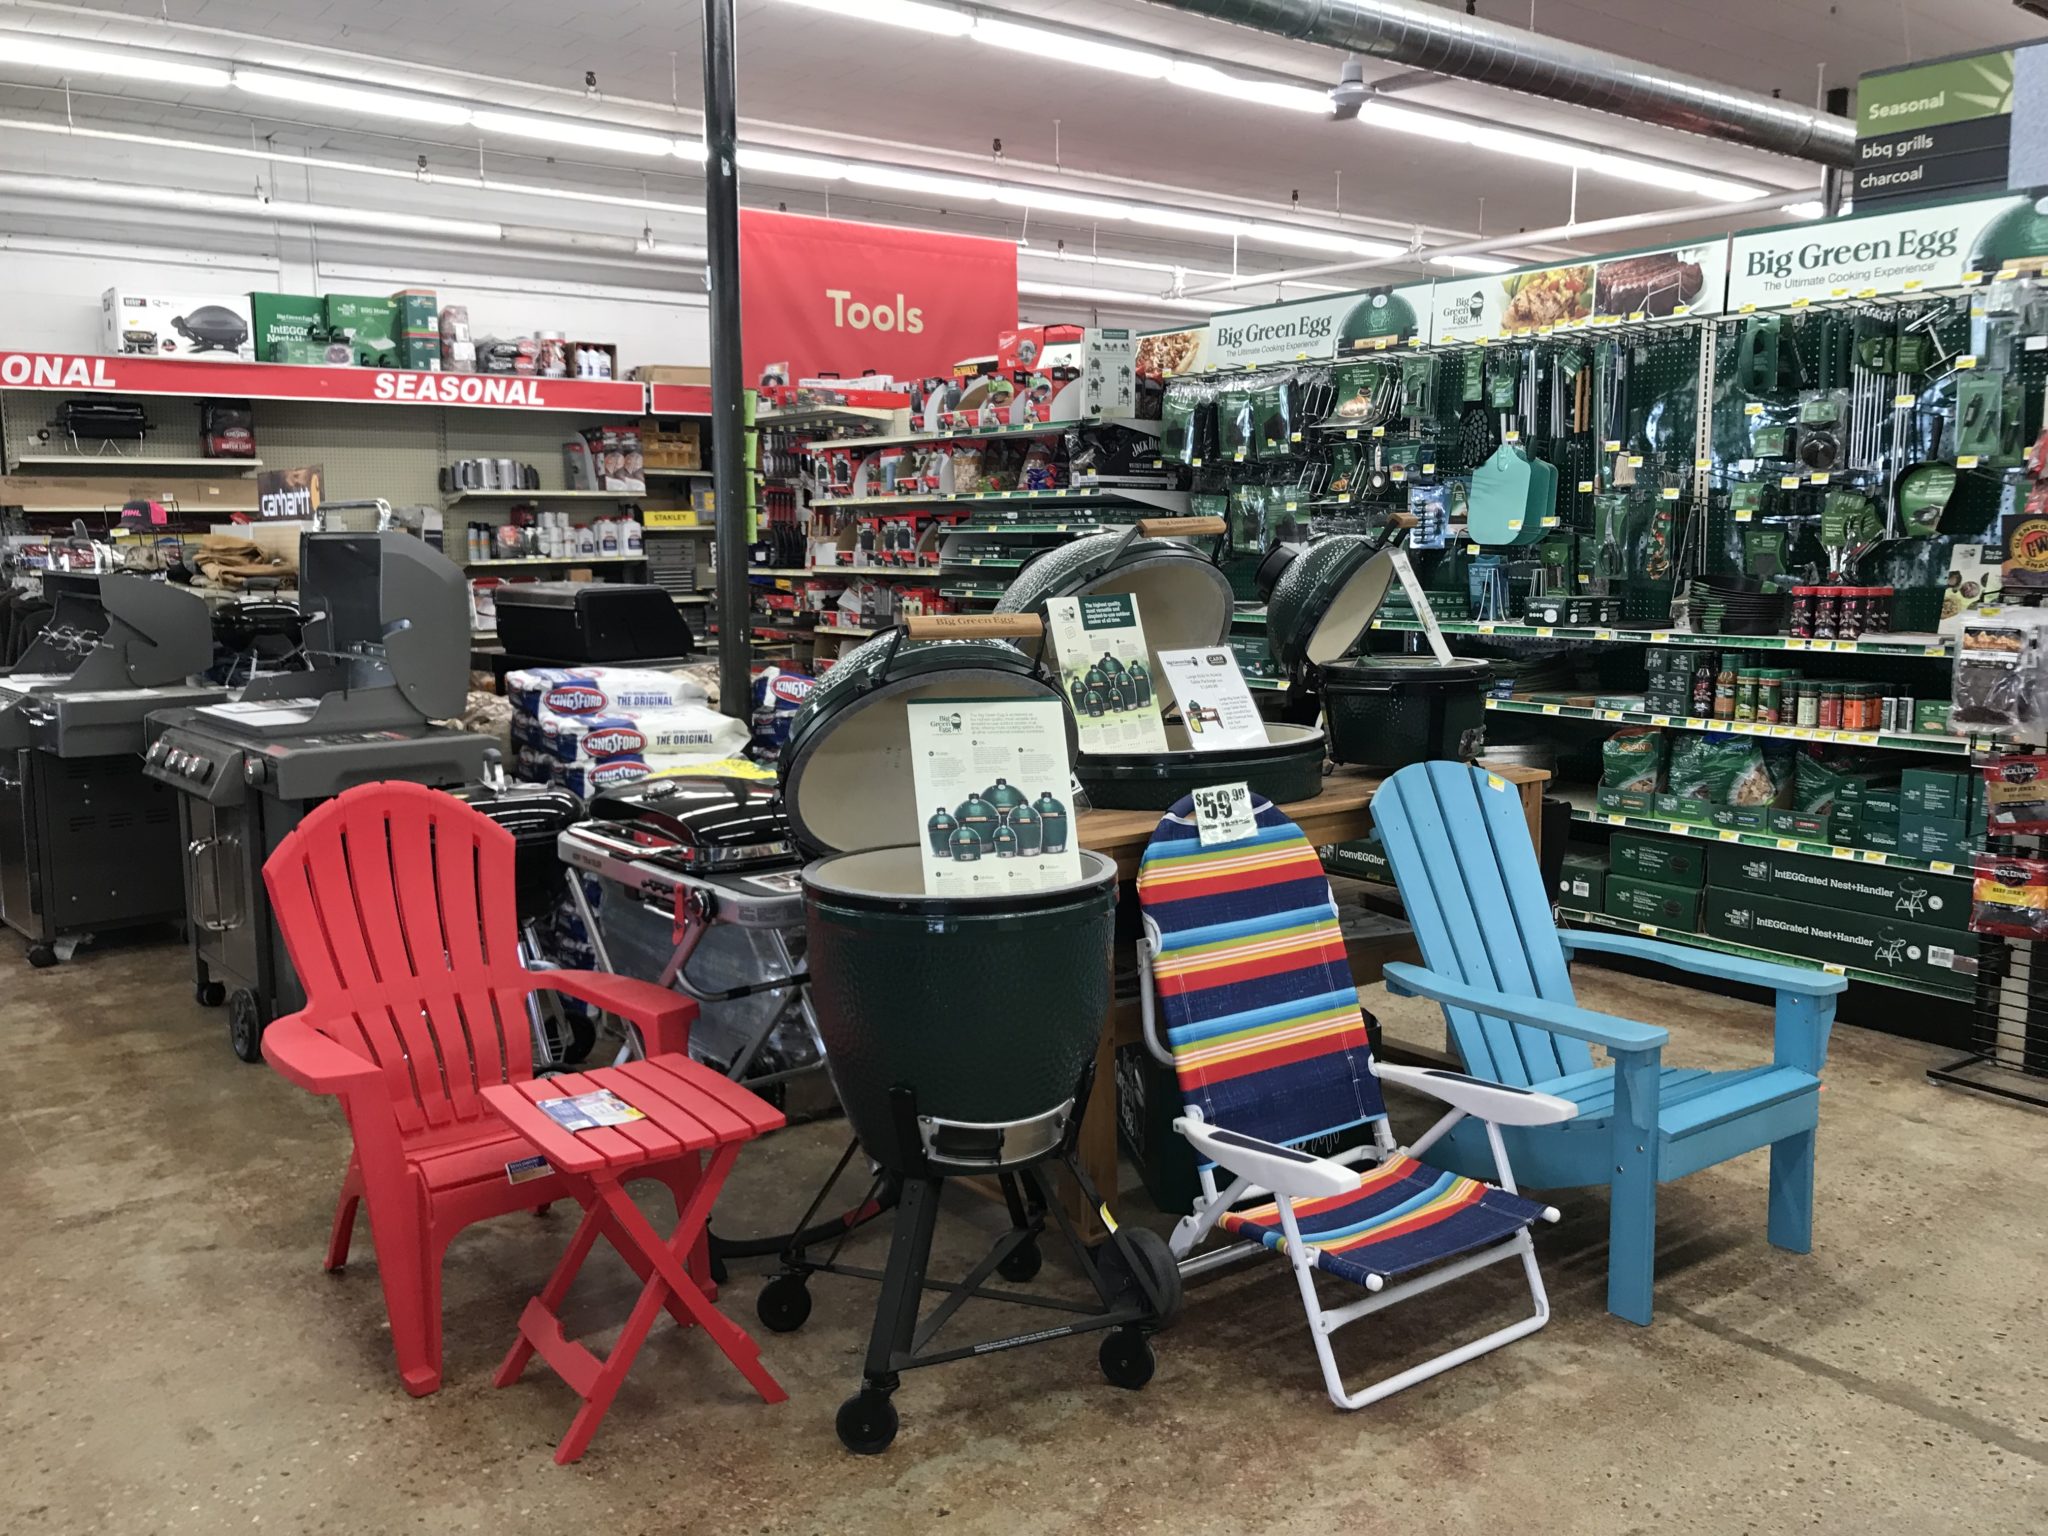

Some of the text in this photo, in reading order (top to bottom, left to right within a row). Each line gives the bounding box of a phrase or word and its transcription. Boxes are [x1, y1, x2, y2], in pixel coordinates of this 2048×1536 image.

[1868, 90, 1945, 120] Seasonal
[1862, 134, 1934, 159] bbq grills
[1860, 164, 1923, 188] charcoal
[1746, 227, 1960, 278] Big Green Egg
[1763, 261, 1938, 291] The Ultimate Cooking Experience
[825, 288, 924, 334] Tools
[1443, 307, 1469, 317] Green
[1456, 297, 1469, 307] Big
[1452, 315, 1469, 325] Egg
[1217, 315, 1332, 348] Big Green Egg
[1226, 350, 1237, 358] The
[1238, 347, 1260, 357] Ultimate
[1261, 343, 1286, 355] Cooking
[1, 354, 116, 387] ONAL
[374, 373, 545, 405] SEASONAL
[1131, 440, 1149, 458] JACK
[261, 487, 311, 517] carhartt
[935, 616, 1015, 626] Big Green Egg
[550, 691, 603, 710] KINGSFORD
[617, 695, 673, 706] THE ORIGINAL
[588, 733, 642, 753] KINGSFORD
[656, 733, 713, 745] THE ORIGINAL
[2018, 785, 2037, 793] JERKY
[1339, 849, 1386, 865] convEGGtor
[1774, 869, 1895, 898] IntEGGrated Nest+Handler
[2007, 888, 2027, 896] JERKY
[1756, 917, 1874, 947] IntEGGrated Nest+Handler
